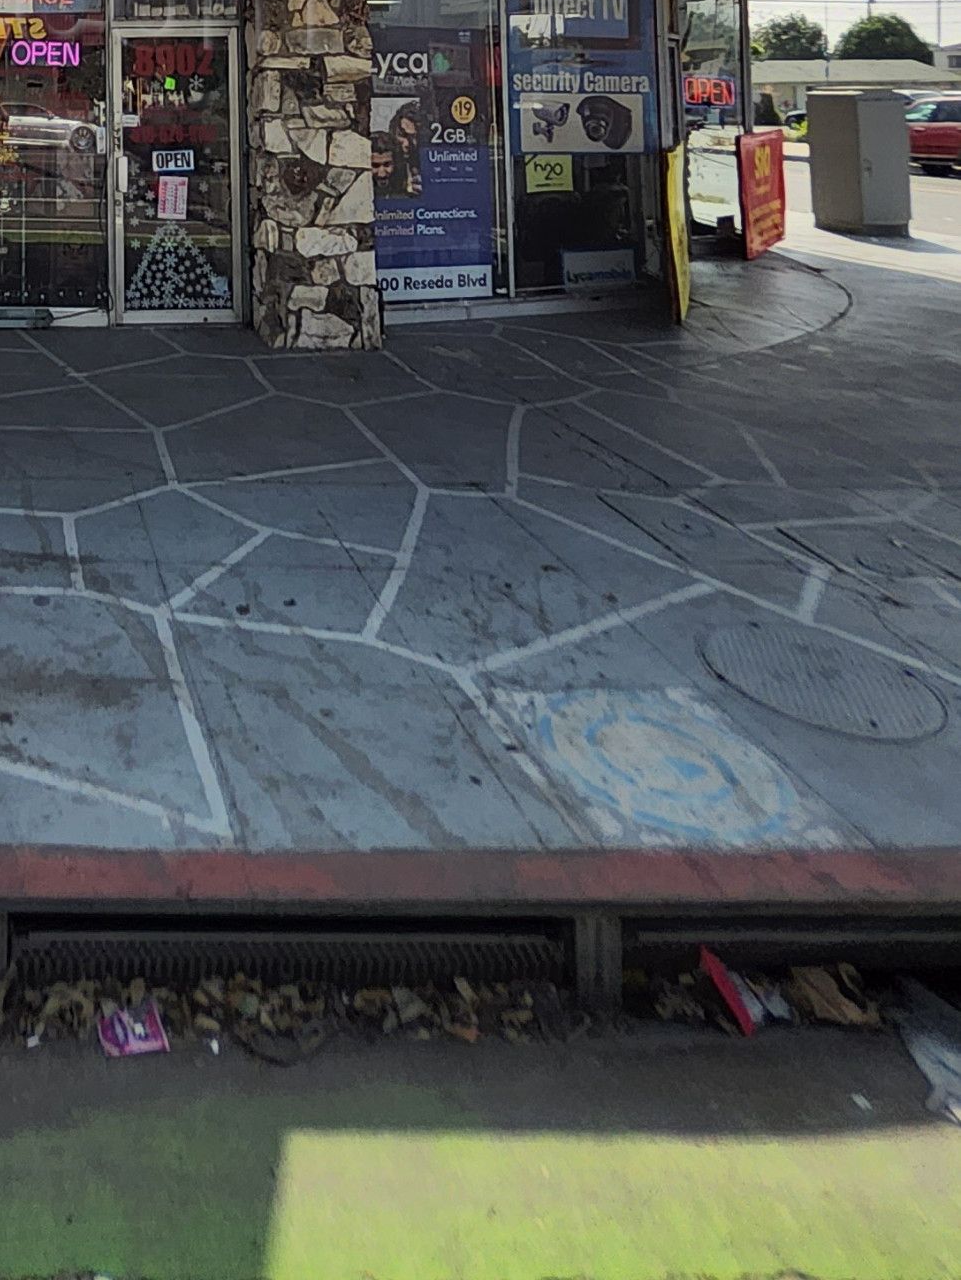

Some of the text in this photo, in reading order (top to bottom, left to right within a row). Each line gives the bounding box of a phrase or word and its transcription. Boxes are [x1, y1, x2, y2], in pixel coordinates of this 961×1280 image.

[11, 40, 80, 67] OPEN
[513, 71, 650, 94] security Camera
[685, 78, 736, 106] OPEN
[156, 151, 191, 168] OPEN
[428, 150, 478, 162] Unlimited
[376, 273, 487, 292] 00 Reseda Blvd
